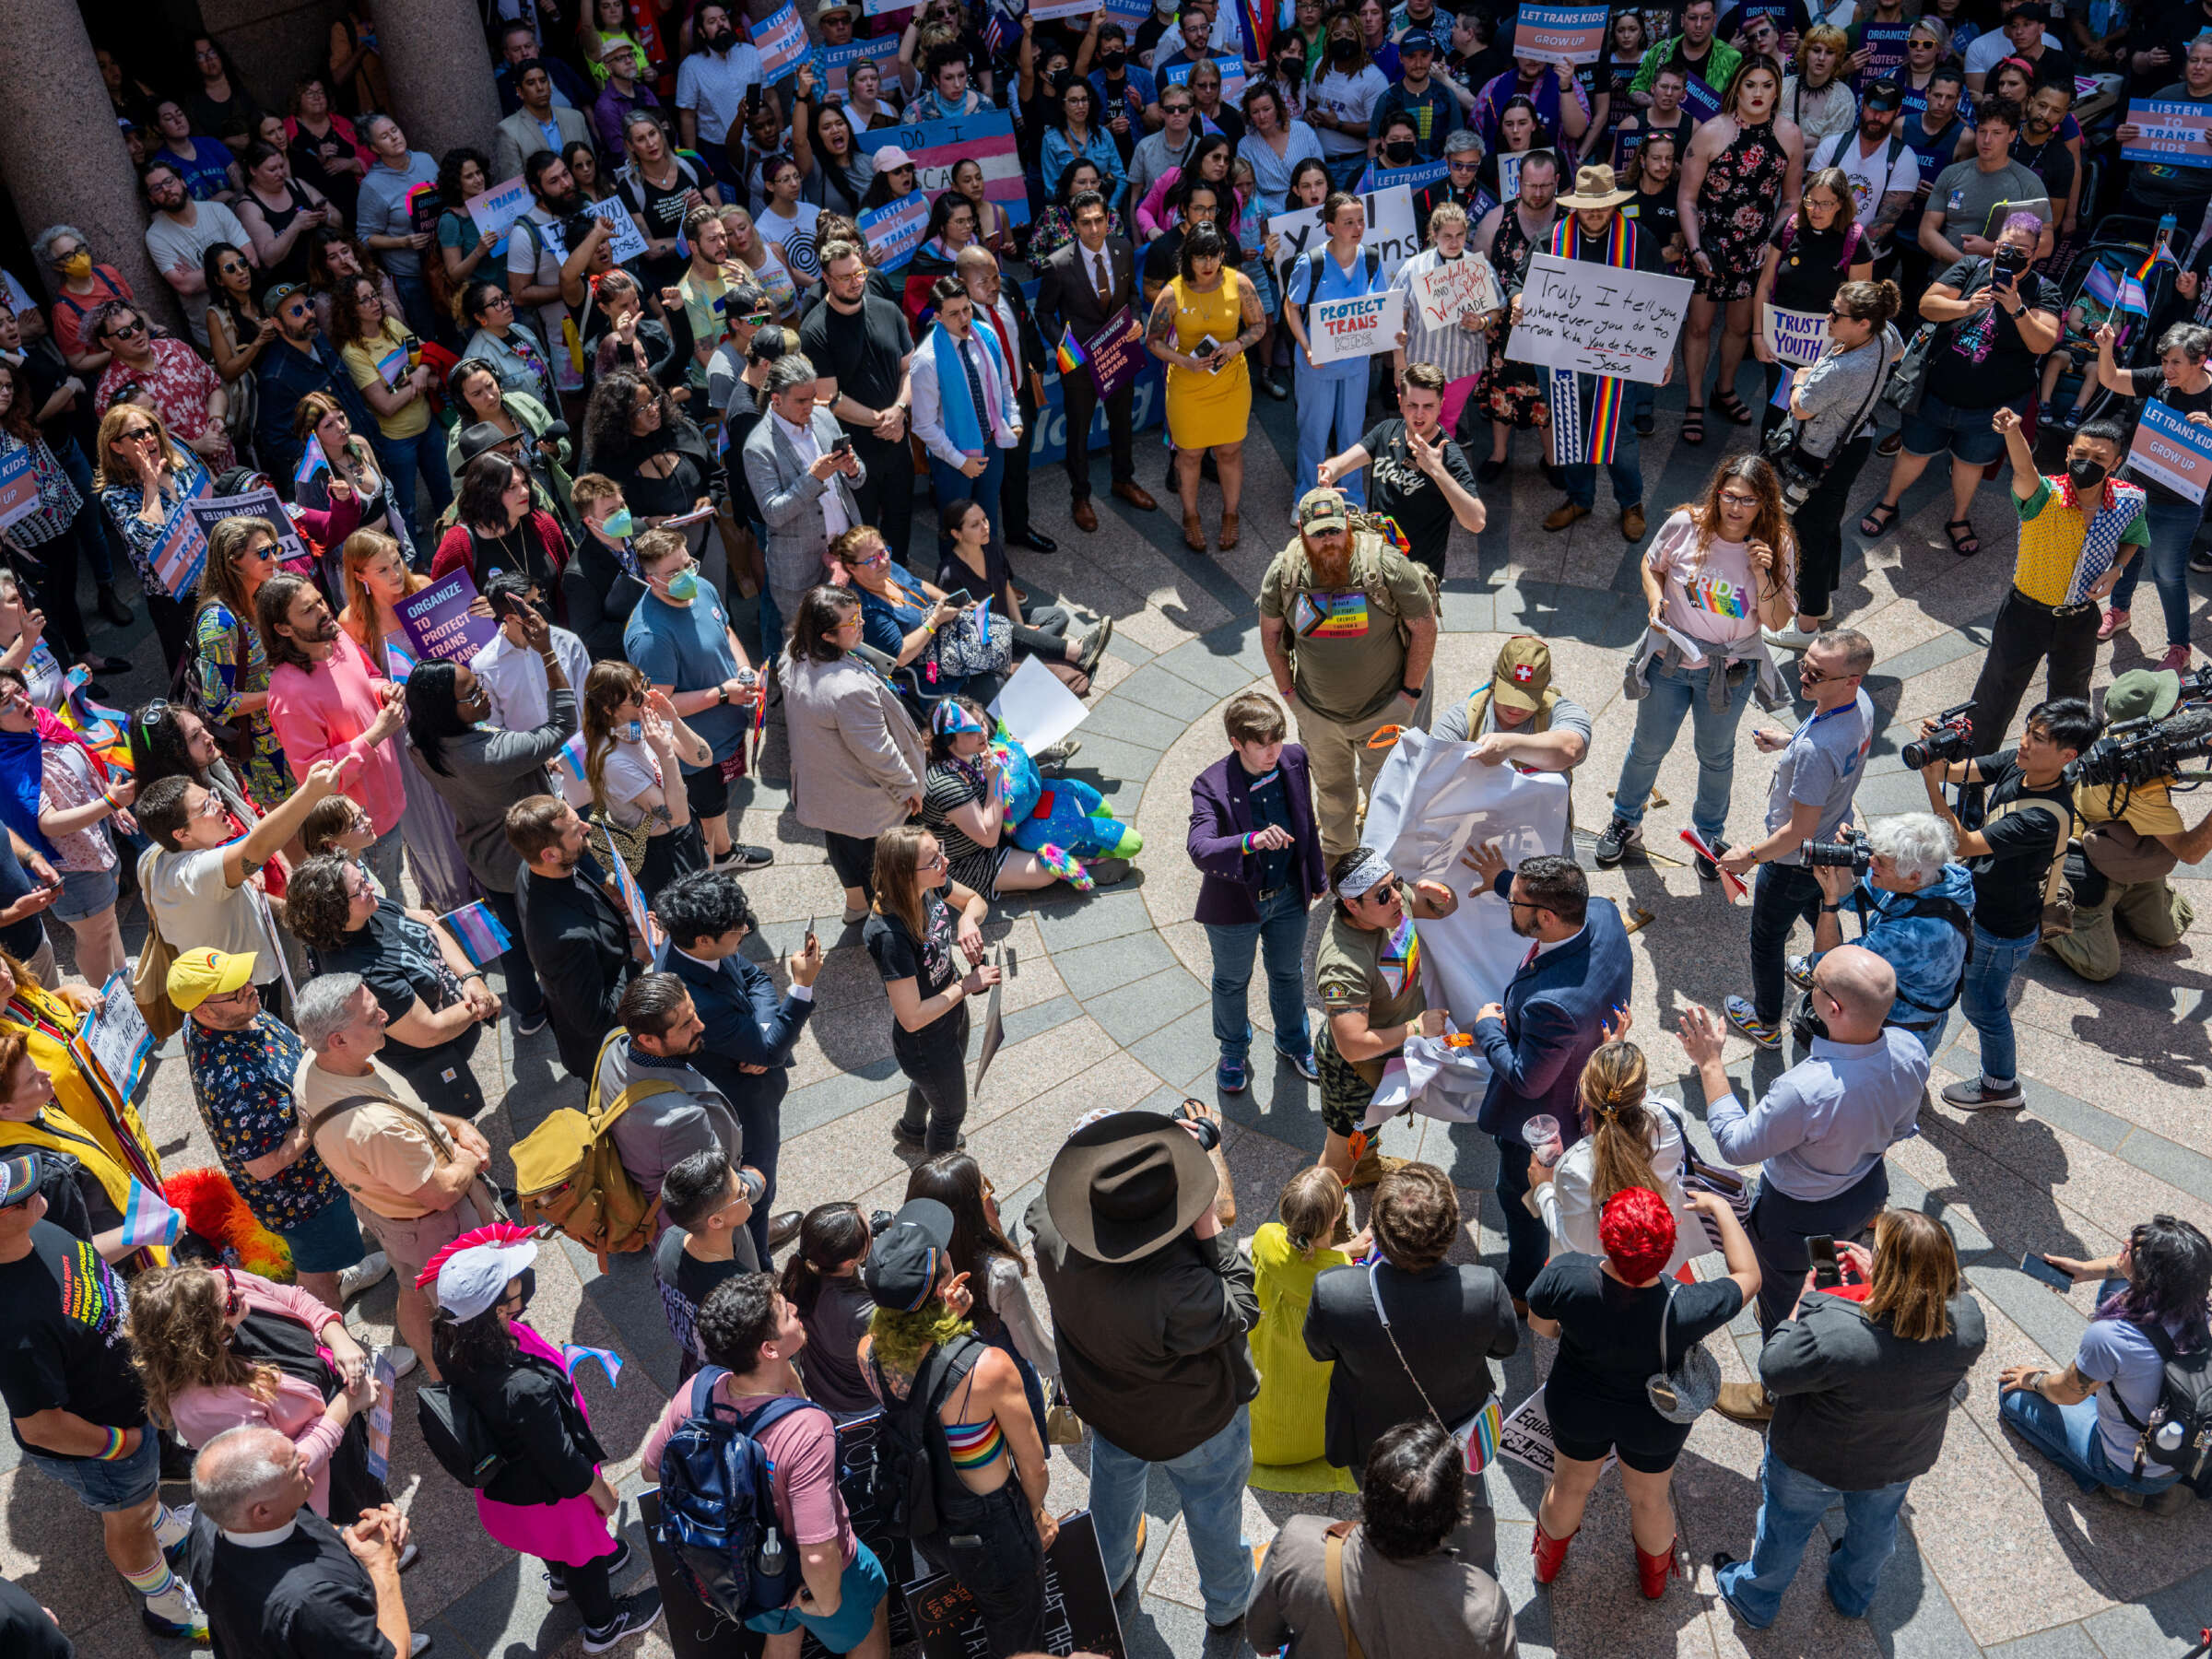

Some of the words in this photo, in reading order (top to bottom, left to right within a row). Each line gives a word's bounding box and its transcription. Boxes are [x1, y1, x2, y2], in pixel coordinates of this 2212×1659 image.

[1521, 10, 1541, 20] LET
[1543, 12, 1579, 24] TRANS
[1580, 12, 1606, 23] KIDS
[1747, 6, 1786, 18] ORGNIZE
[1535, 34, 1571, 46] GROW
[1571, 36, 1585, 46] UP
[1867, 29, 1910, 41] ORGANIZE
[828, 51, 844, 63] LET
[846, 45, 877, 59] TRANS
[878, 40, 899, 53] KIDS
[1869, 54, 1903, 65] ROTECT
[1170, 70, 1187, 82] LET
[1219, 62, 1241, 73] KIDS
[1863, 66, 1886, 76] TRAN
[1686, 80, 1721, 112] ORGANIZE
[1901, 97, 1928, 112] GANIZ
[2148, 103, 2203, 117] LISTEN
[2164, 117, 2183, 127] TO
[900, 130, 925, 151] DO
[947, 125, 967, 144] I
[2147, 128, 2196, 141] TRANS
[2150, 141, 2186, 154] KIDS
[1378, 174, 1396, 186] LET
[1397, 170, 1431, 183] TRANS
[1432, 165, 1451, 179] KID
[489, 188, 523, 212] TRANS
[875, 198, 911, 224] LISTEN
[889, 217, 903, 229] TO
[885, 223, 918, 248] TRANS
[891, 237, 917, 257] KIDS
[1432, 286, 1450, 299] AND
[1534, 266, 1583, 309] Truly
[1594, 286, 1618, 307] I
[1623, 288, 1653, 312] tell
[1320, 297, 1386, 322] PROTECT
[1456, 296, 1488, 318] MADE
[1324, 315, 1379, 335] TRANS
[1522, 302, 1594, 327] whatever
[1594, 320, 1623, 335] you
[1632, 318, 1644, 332] do
[1653, 324, 1669, 339] to
[1773, 311, 1826, 335] TRUST
[1089, 316, 1125, 351] ORGANIZE
[1092, 346, 1103, 359] TO
[1094, 337, 1127, 367] PROTECT
[1607, 338, 1619, 351] do
[1624, 340, 1638, 354] to
[1774, 330, 1823, 362] YOUTH
[1096, 350, 1122, 375] TRANS
[1099, 355, 1129, 382] TEXANS
[2145, 406, 2164, 423] LET
[2163, 416, 2196, 441] TRANS
[2194, 431, 2212, 450] KID
[2, 454, 28, 477] KIDS
[2149, 441, 2181, 464] GROW
[2181, 455, 2195, 471] UP
[3, 488, 18, 504] UP
[234, 503, 268, 517] HIGH
[178, 519, 193, 538] TO
[185, 540, 206, 567] KID
[1686, 570, 1745, 601] PRIDE
[407, 581, 464, 619] ORGANIZE
[413, 616, 431, 633] TO
[421, 611, 471, 647] PROTECT
[429, 631, 468, 658] TRANS
[448, 642, 480, 665] XANS
[62, 1254, 72, 1280] RIGHTS
[62, 1281, 72, 1315] HUMAN
[71, 1275, 82, 1319] EQUALITY
[80, 1273, 92, 1324] AFFORDABLE
[660, 1278, 699, 1325] PROTEC
[88, 1291, 102, 1327] GLOBAL
